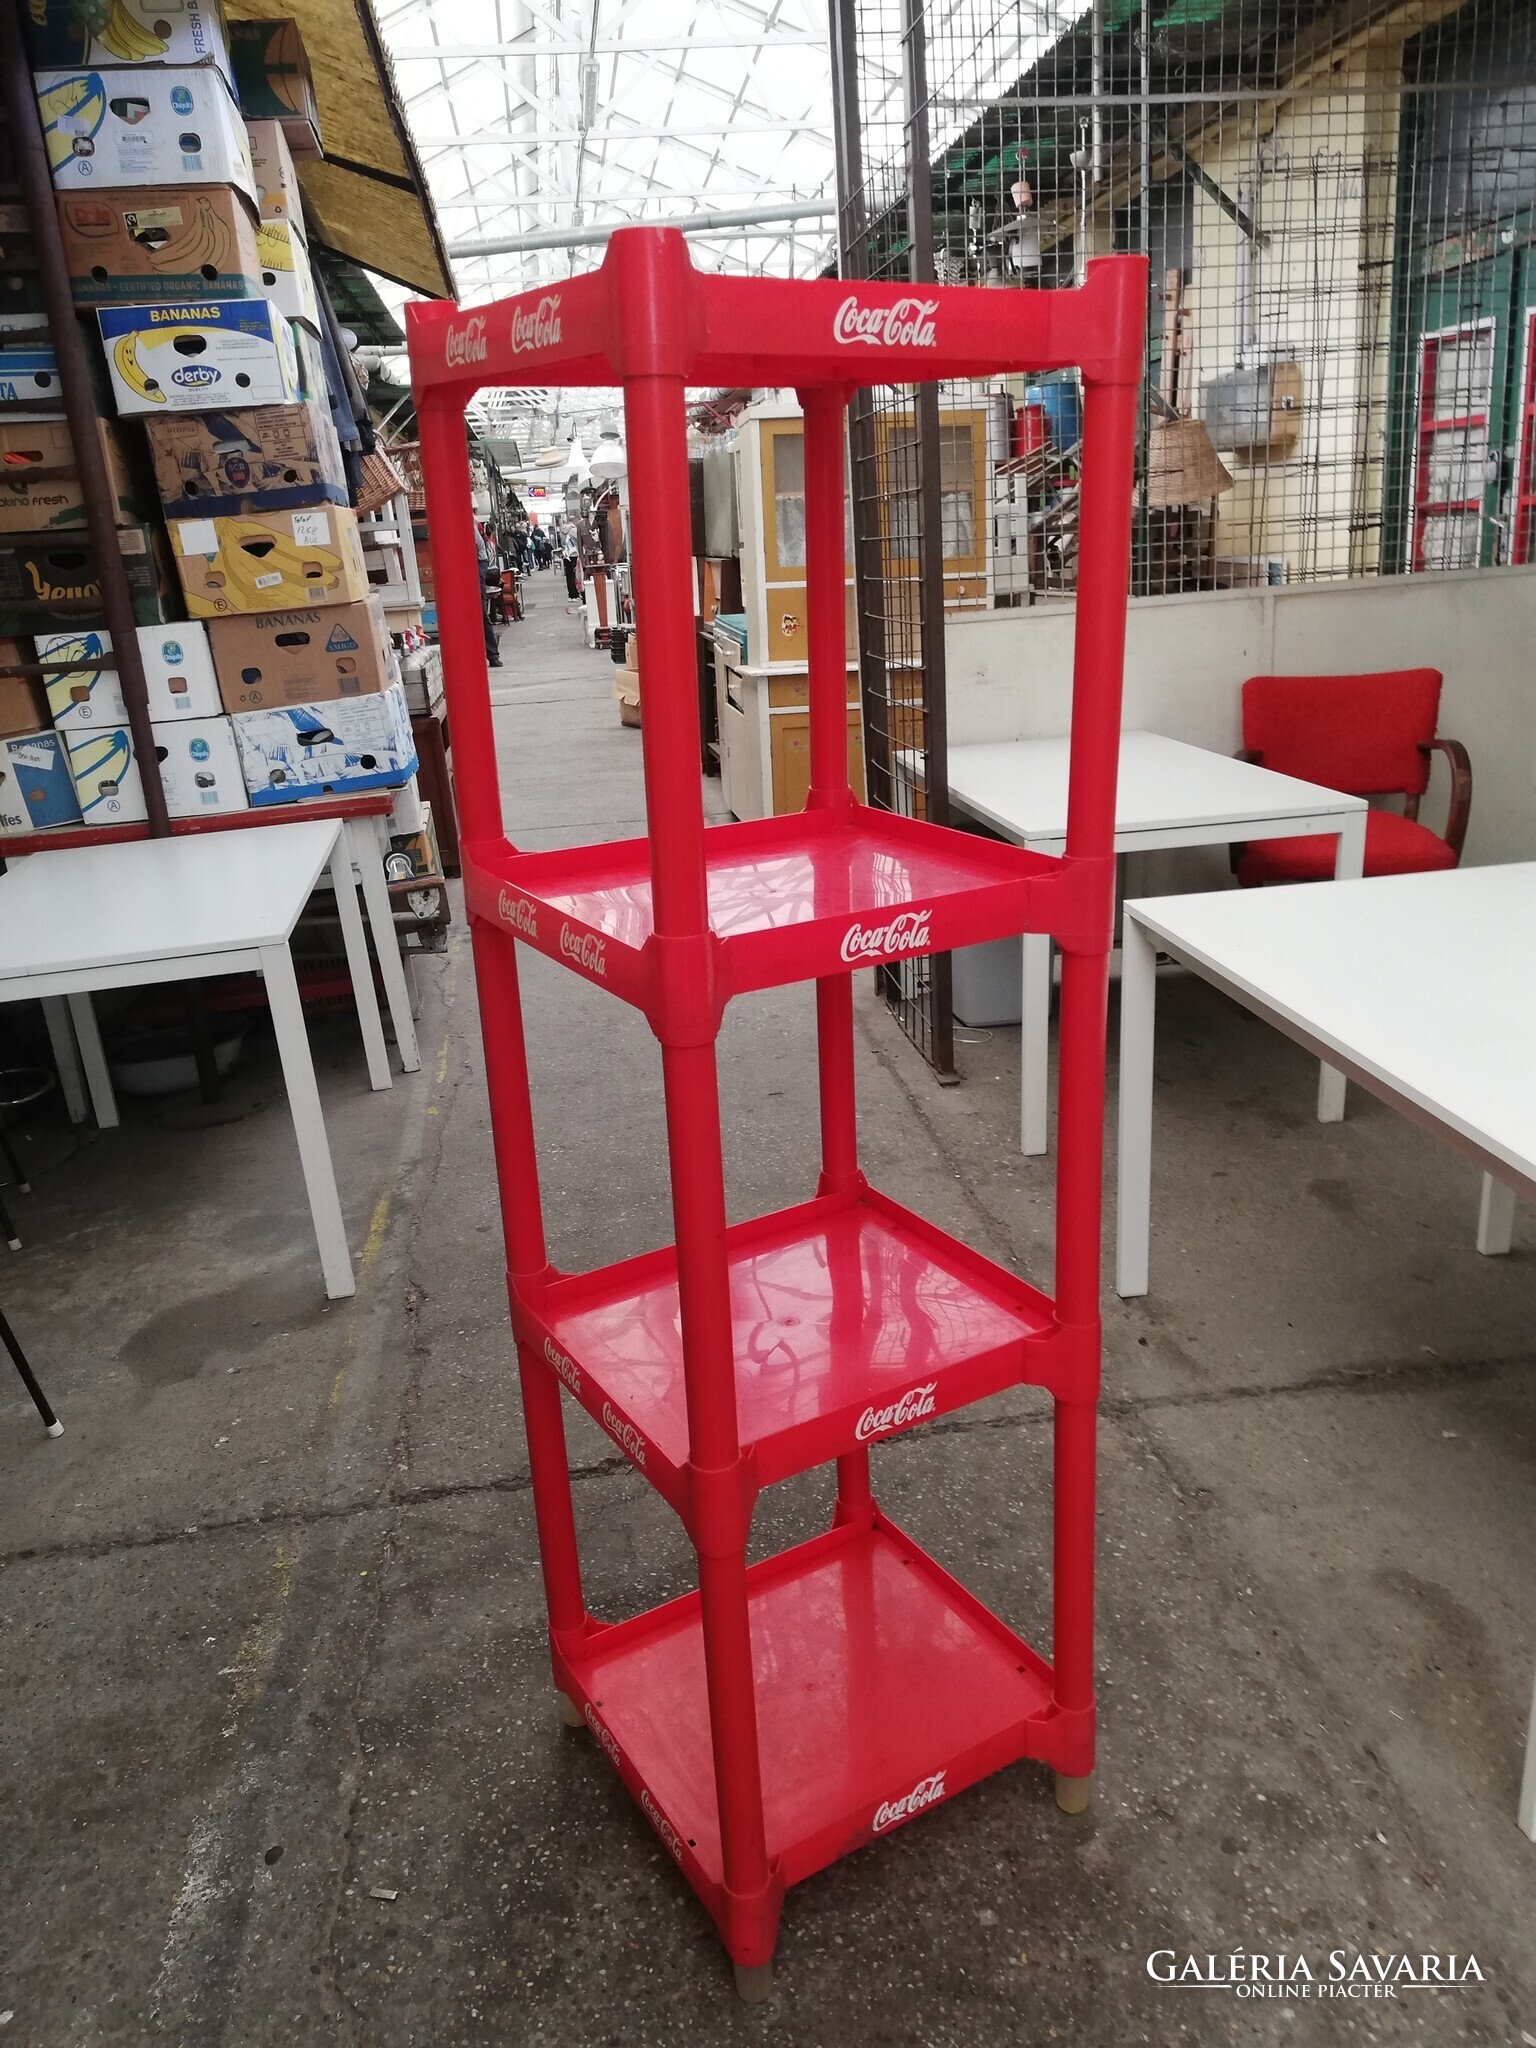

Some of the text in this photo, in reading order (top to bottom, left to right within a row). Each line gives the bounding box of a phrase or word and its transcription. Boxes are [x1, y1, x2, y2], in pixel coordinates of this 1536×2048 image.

[191, 14, 206, 54] FRESH
[119, 281, 161, 291] CERTIFIED
[163, 281, 200, 290] ORGANIC
[202, 280, 243, 290] BANANAS
[150, 307, 220, 322] BANANAS
[511, 294, 562, 354] Coca-Cola
[833, 296, 939, 346] Coca-Cola
[445, 315, 487, 367] Coca-Cola
[174, 367, 218, 384] derby
[228, 462, 245, 471] SCB
[256, 612, 321, 629] BANANAS
[328, 642, 357, 650] AMIGO
[498, 889, 538, 938] Coca-Cola
[840, 908, 933, 962] Coca-Cola
[560, 922, 606, 976] Coca-Cola
[543, 1337, 581, 1393] Coca-Cola
[602, 1401, 646, 1466] Coca-Cola
[855, 1381, 937, 1440] Coca-Cola
[872, 1769, 947, 1832] Coca-Cola
